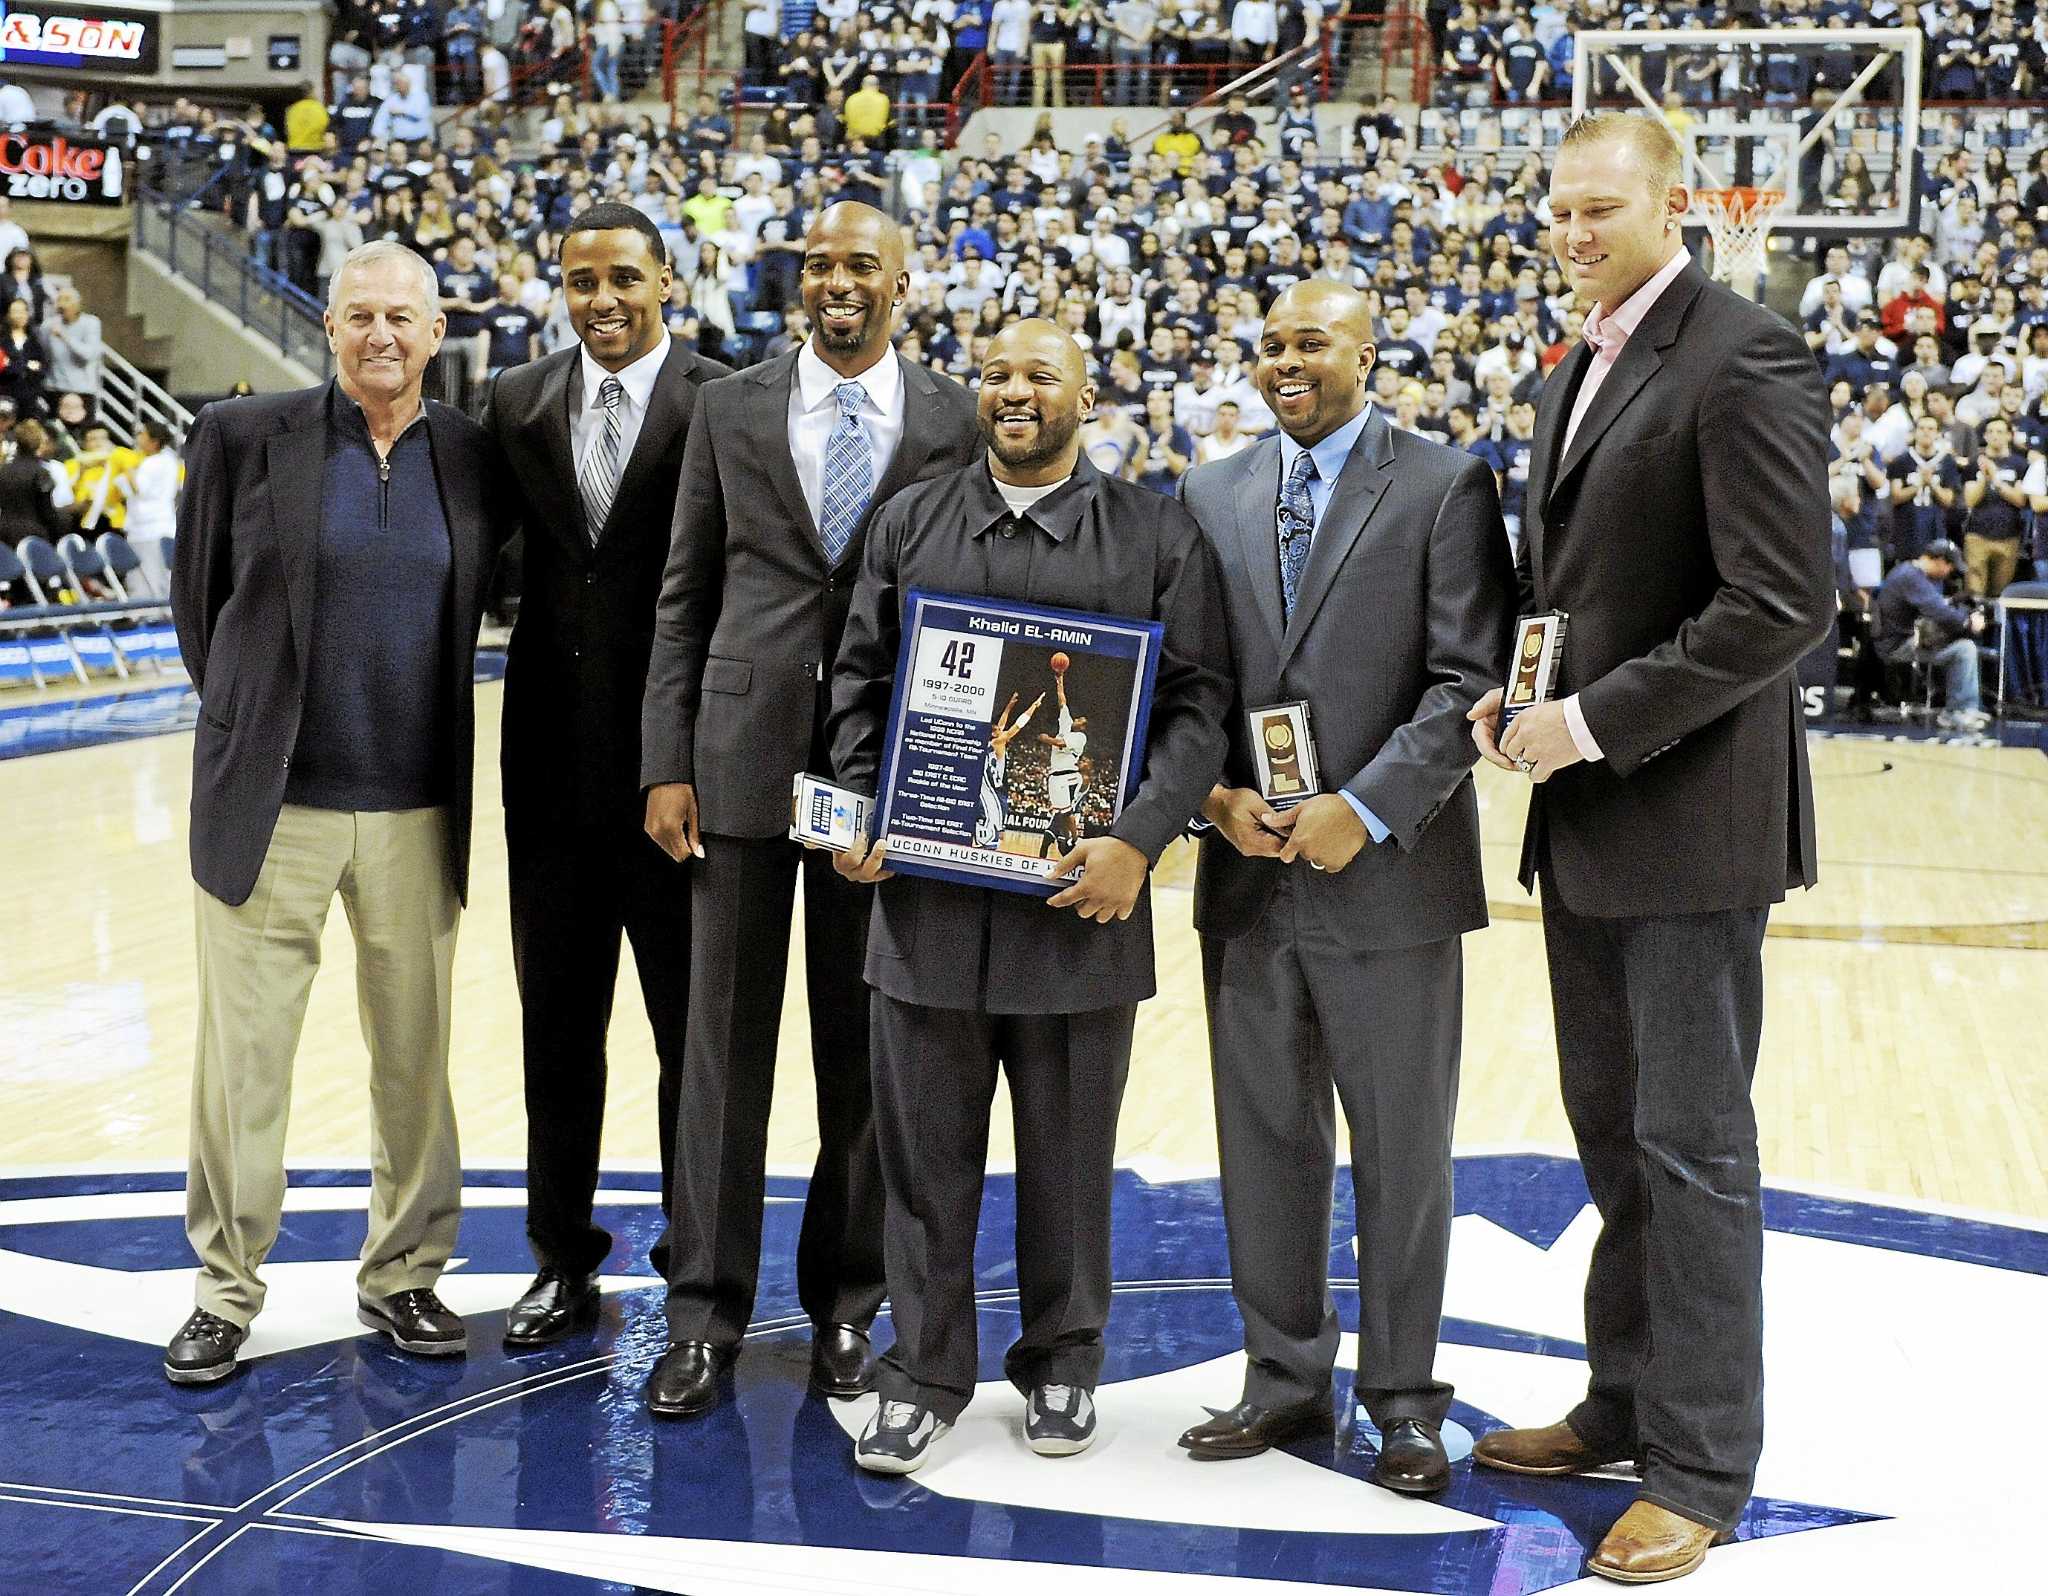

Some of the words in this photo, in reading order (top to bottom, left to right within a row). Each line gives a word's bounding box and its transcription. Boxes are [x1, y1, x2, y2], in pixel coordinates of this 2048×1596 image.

[42, 16, 146, 59] SON
[0, 132, 105, 181] Coke
[8, 173, 87, 201] zero
[969, 616, 1020, 635] Khalid
[1024, 624, 1092, 646] EL-AMIN
[940, 640, 976, 679] 42
[922, 679, 985, 696] 1997-2000
[920, 716, 933, 724] Led
[956, 721, 963, 729] to
[960, 752, 978, 761] Team
[957, 799, 975, 808] EAST
[946, 820, 964, 828] EAST
[1022, 816, 1050, 830] FOUR
[892, 838, 942, 855] UCONN
[949, 849, 1014, 867] HUSKIES
[1021, 860, 1040, 871] OF
